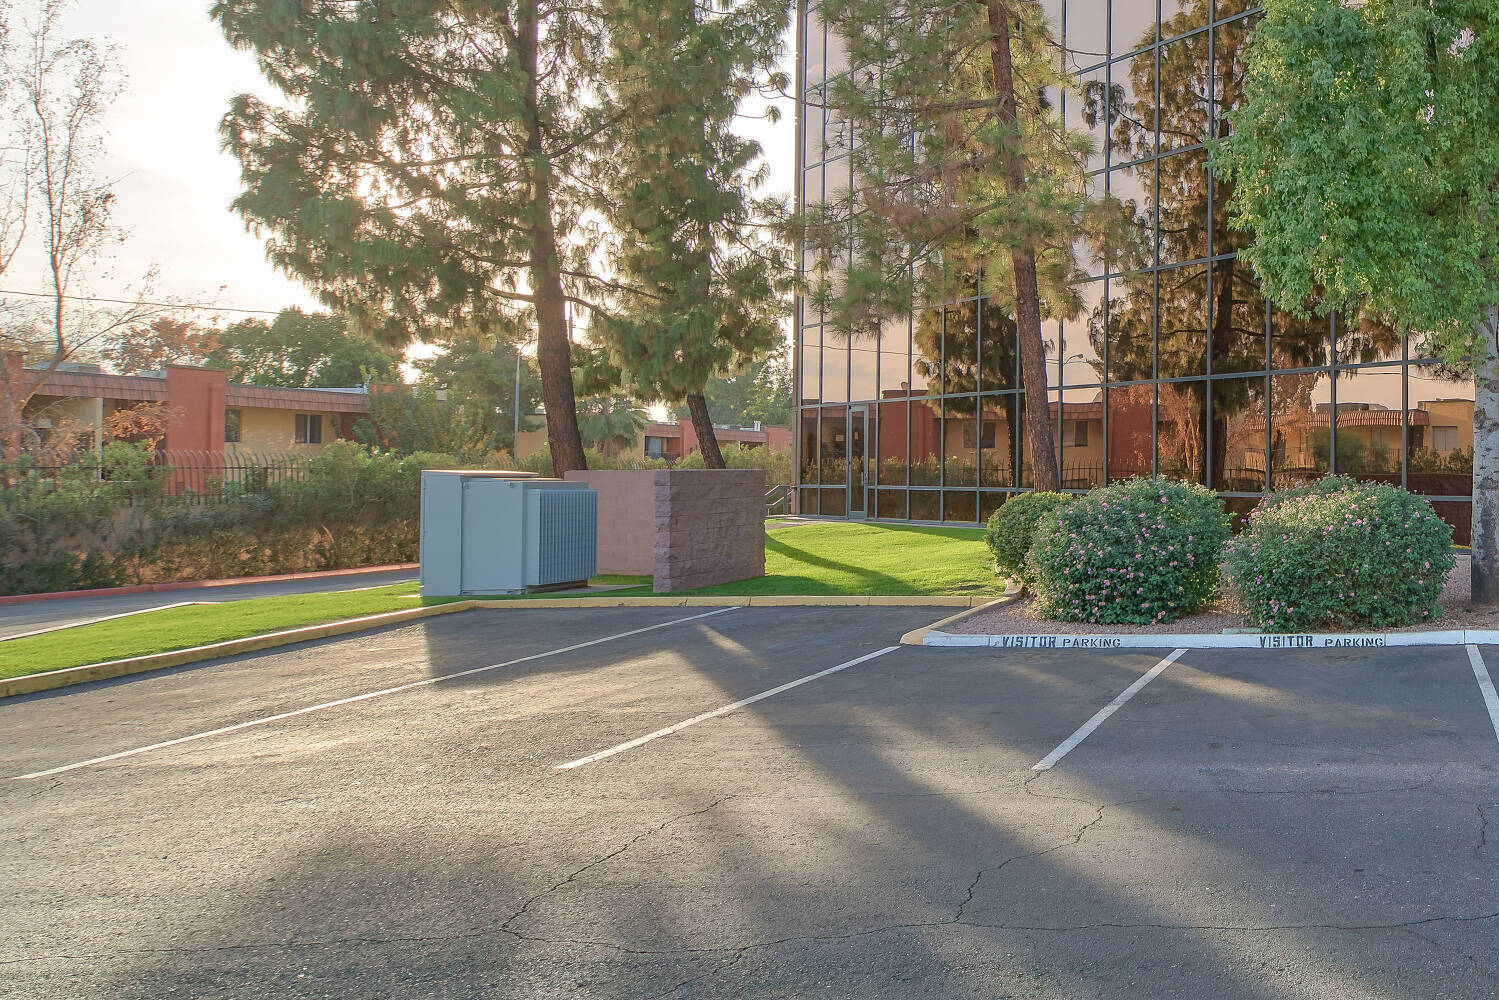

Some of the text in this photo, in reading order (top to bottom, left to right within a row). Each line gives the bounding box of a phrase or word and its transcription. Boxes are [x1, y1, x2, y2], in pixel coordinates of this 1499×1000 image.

[1002, 636, 1121, 648] VISITOR PARKING
[1260, 635, 1383, 648] VISITOR PARKING
